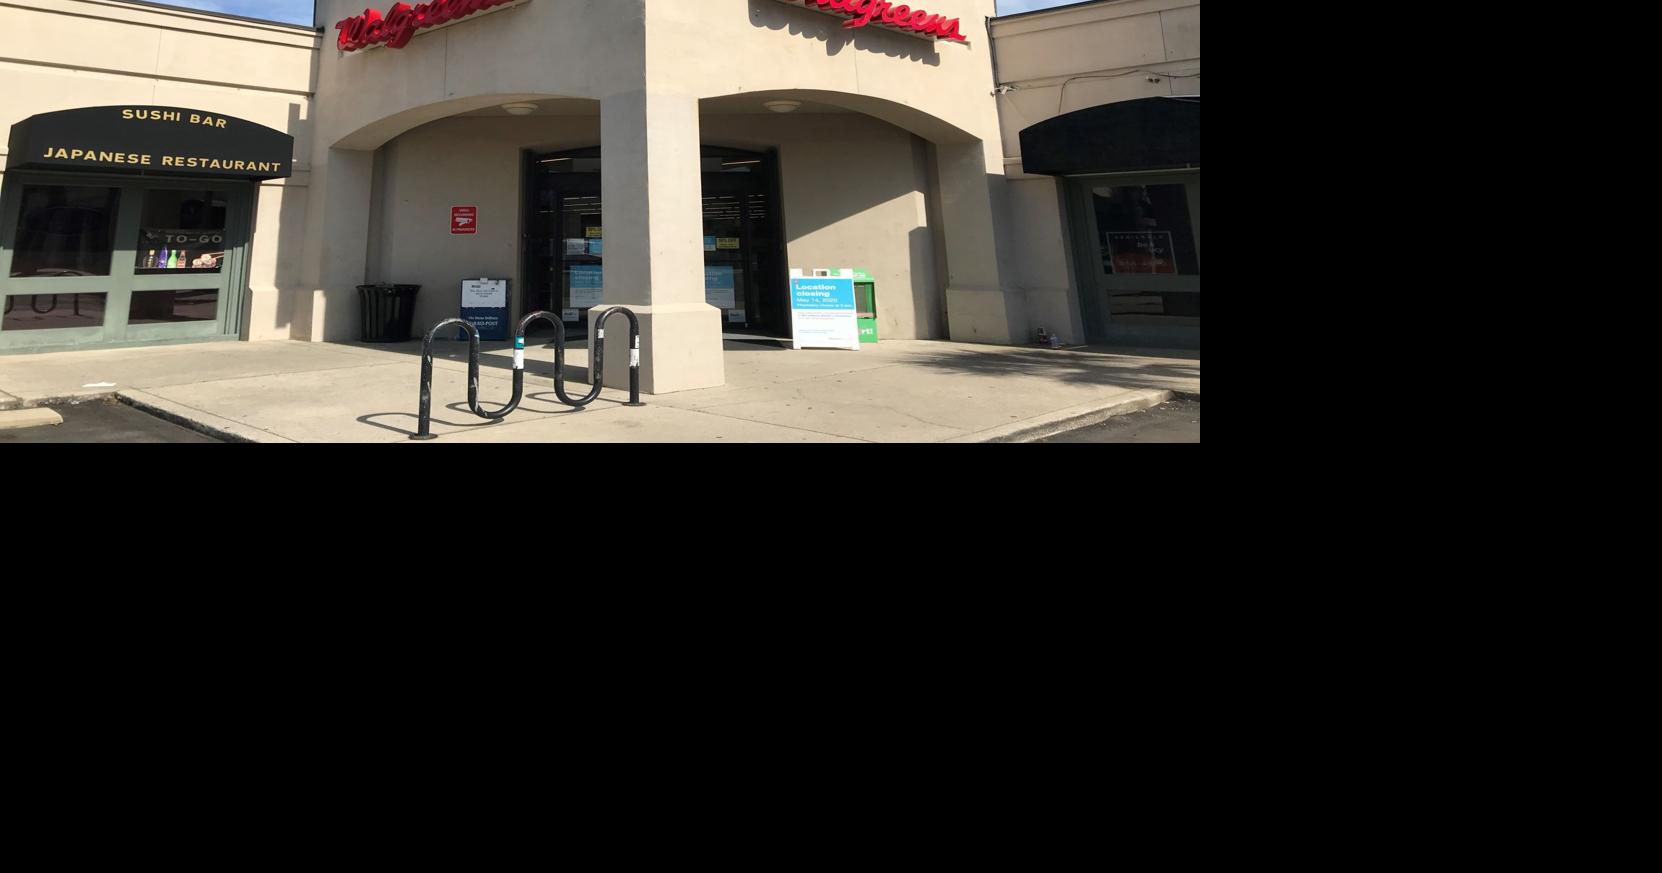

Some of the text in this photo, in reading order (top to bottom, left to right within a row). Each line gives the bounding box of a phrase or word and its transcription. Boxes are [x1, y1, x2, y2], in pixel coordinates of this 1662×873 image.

[121, 108, 228, 129] SUSHI BAR
[43, 147, 281, 172] JAPANESE RESTAURANT
[165, 234, 222, 243] TO-GO
[796, 290, 830, 298] closing
